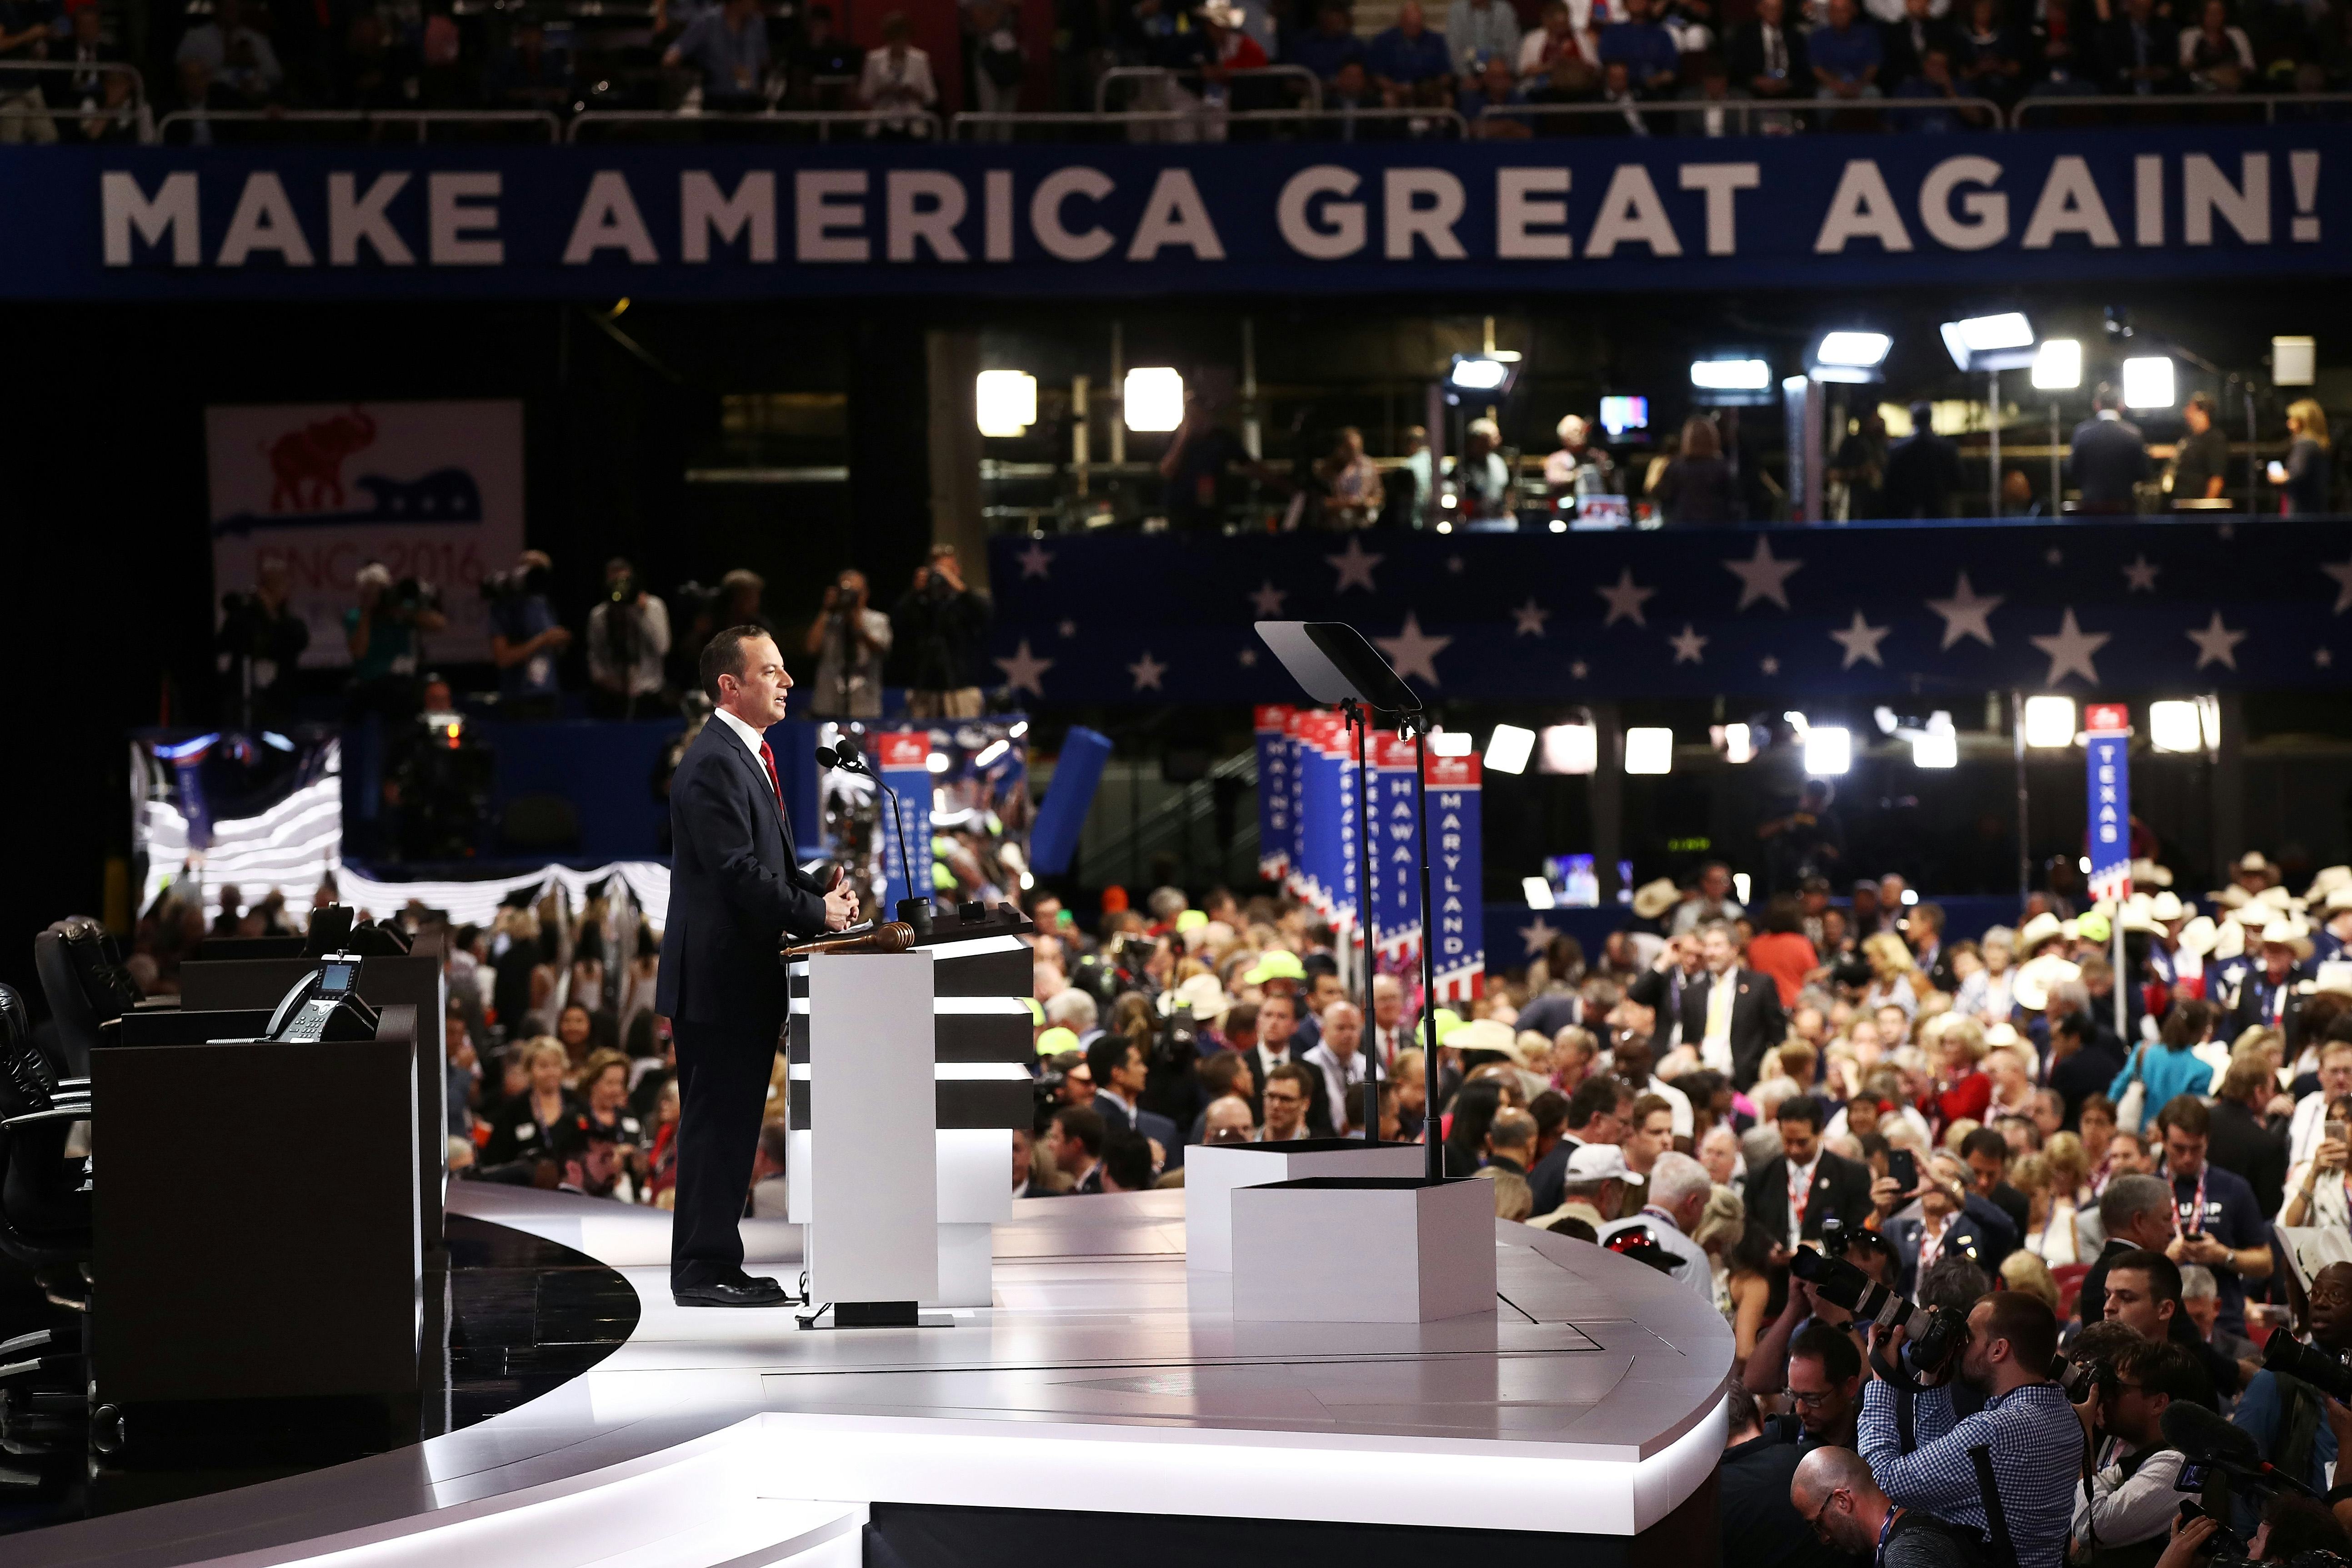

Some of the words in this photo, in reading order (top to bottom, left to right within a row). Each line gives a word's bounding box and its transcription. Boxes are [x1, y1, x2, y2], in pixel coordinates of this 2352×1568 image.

[103, 174, 501, 264] MAKE
[566, 169, 1223, 260] AMERICA
[1278, 163, 1760, 258] GREAT
[1815, 152, 2321, 253] AGAIN!
[1390, 778, 1414, 907] HAWAII
[1440, 793, 1463, 955] MARYLAND
